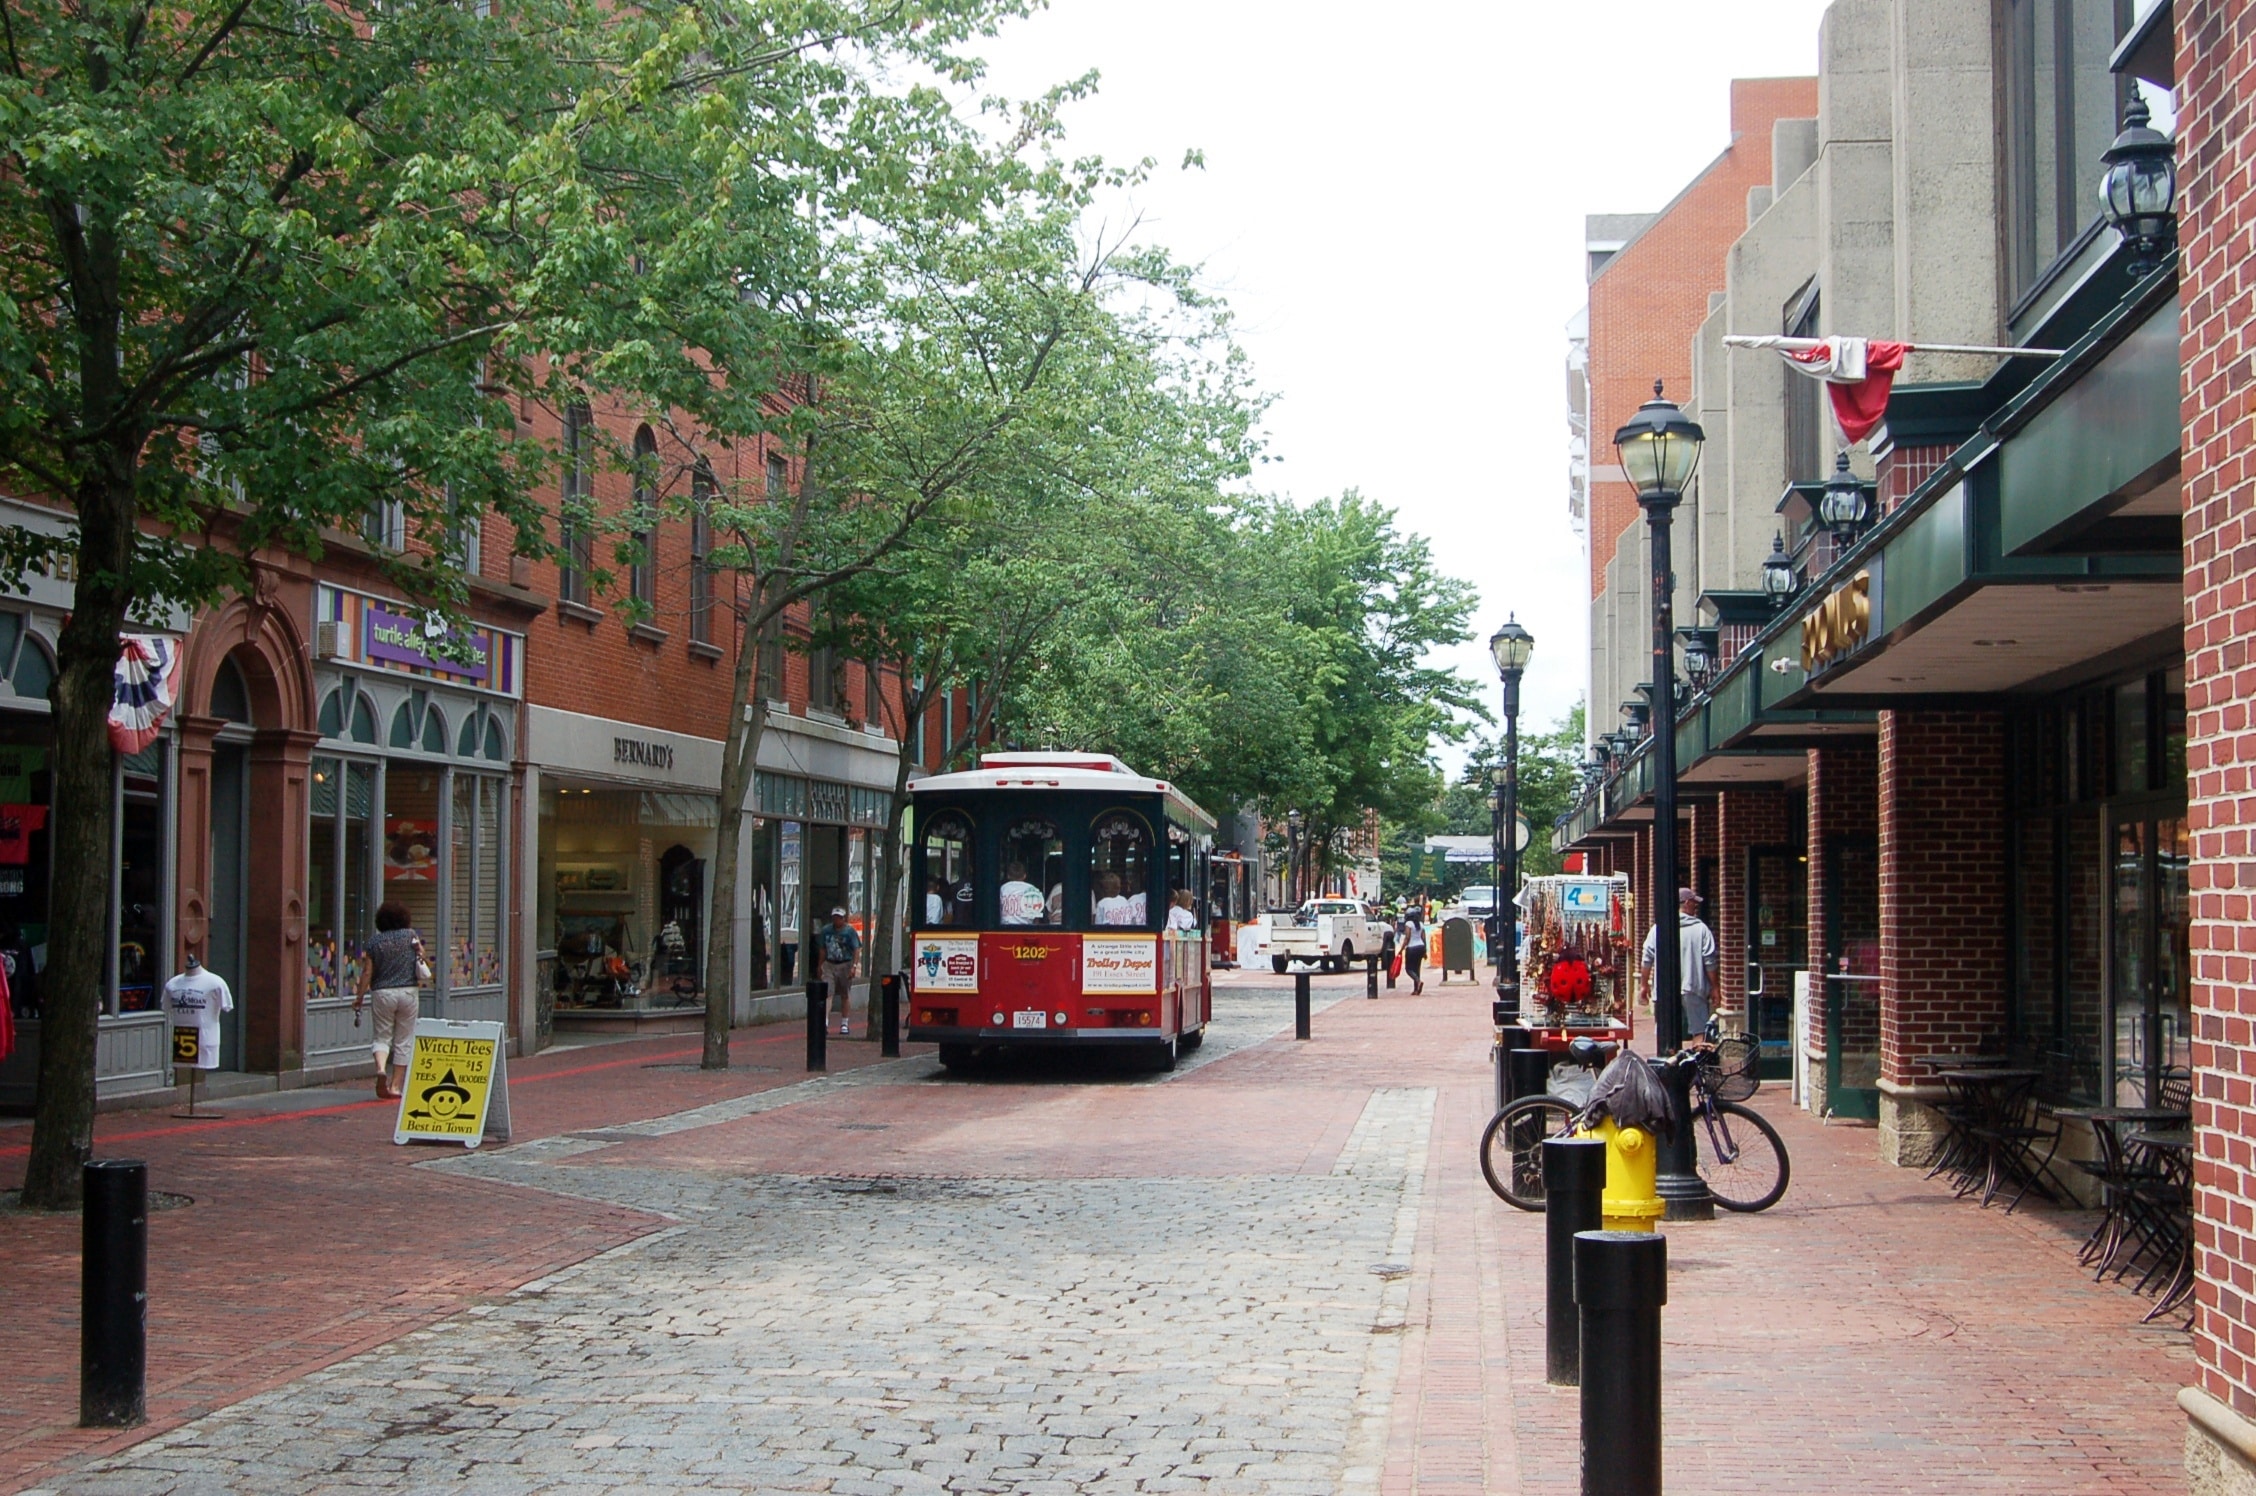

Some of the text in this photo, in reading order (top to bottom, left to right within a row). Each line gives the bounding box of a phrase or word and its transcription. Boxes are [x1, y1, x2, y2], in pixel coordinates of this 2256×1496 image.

[374, 623, 403, 646] turtle
[404, 627, 427, 658] alley
[614, 737, 674, 769] BERNARD'S
[1015, 946, 1046, 959] 1202
[1086, 957, 1152, 971] Trolley Depot
[1018, 1016, 1040, 1025] 15574
[419, 1038, 492, 1056] Witch Tees
[420, 1057, 433, 1070] $5
[466, 1061, 483, 1072] $15
[415, 1072, 437, 1081] TEES
[458, 1074, 488, 1084] HOODIES
[407, 1120, 473, 1134] Best in Town
